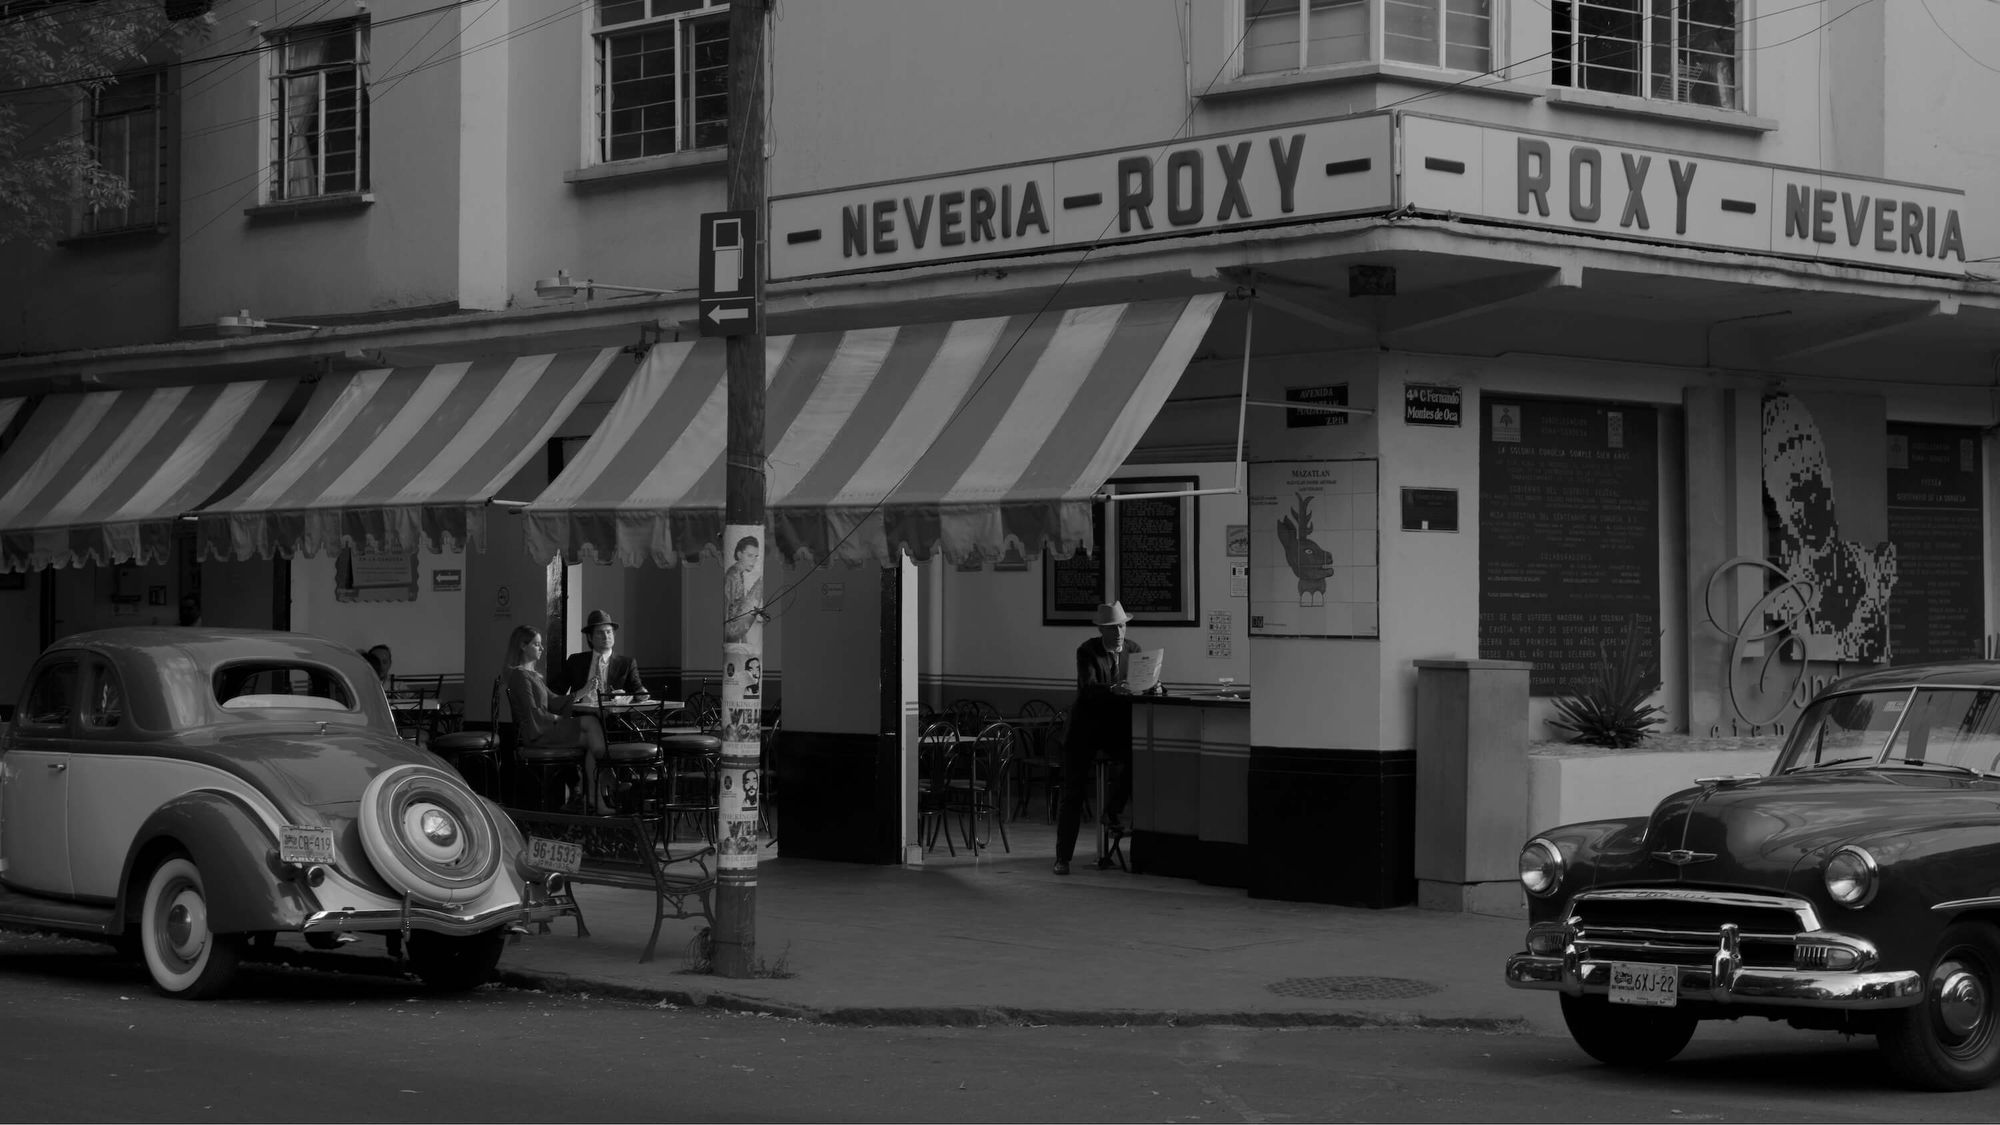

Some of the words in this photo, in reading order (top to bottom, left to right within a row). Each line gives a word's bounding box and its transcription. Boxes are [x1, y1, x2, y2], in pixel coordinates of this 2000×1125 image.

[842, 182, 1050, 258] NEVERIA
[1117, 134, 1306, 233] ROXY
[1517, 136, 1697, 234] ROXY
[1784, 183, 1966, 262] NEVERIA
[1299, 387, 1334, 399] AVENIDA
[1427, 390, 1460, 405] Fernando
[1407, 405, 1434, 419] Montes
[1434, 407, 1443, 420] de
[1443, 408, 1458, 421] Oca
[1292, 470, 1330, 478] MAZATLAN
[1634, 973, 1674, 993] 6XJ-22
